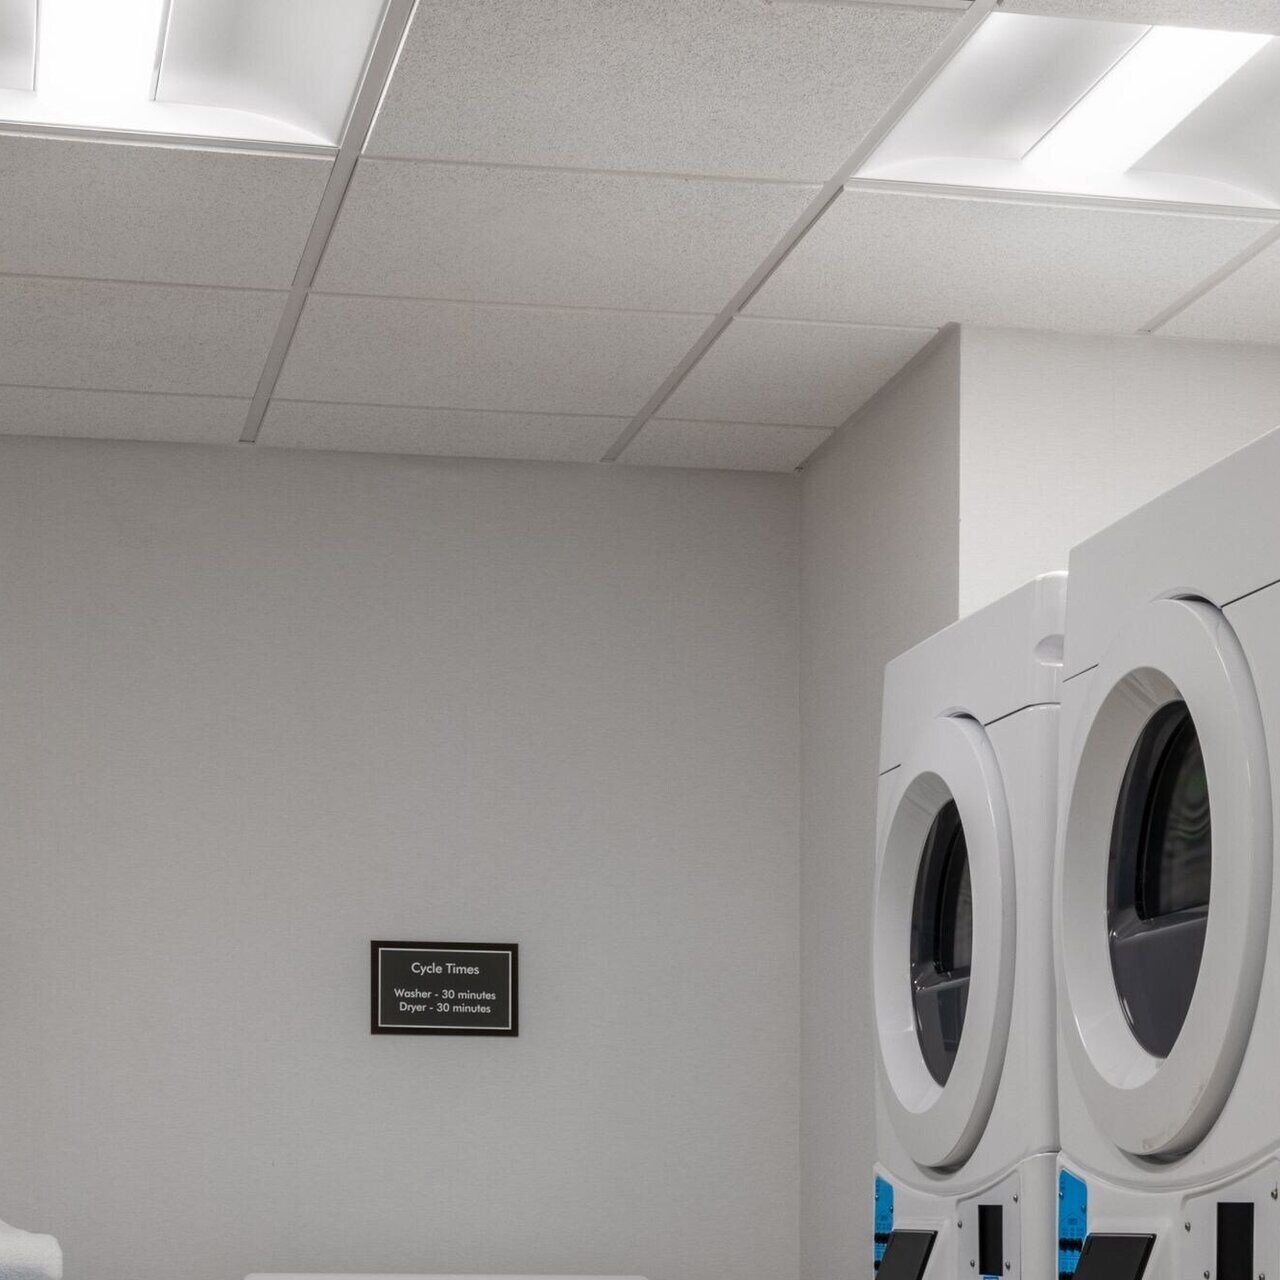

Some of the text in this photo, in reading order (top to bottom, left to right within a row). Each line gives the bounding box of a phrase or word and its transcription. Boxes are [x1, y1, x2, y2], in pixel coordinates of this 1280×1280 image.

[411, 962, 480, 976] Cycle Times
[394, 988, 432, 998] Washer
[441, 989, 455, 999] 30
[458, 990, 496, 1000] minutes
[399, 1002, 427, 1013] Dryer
[436, 1003, 450, 1012] 30
[452, 1003, 491, 1013] minutes
